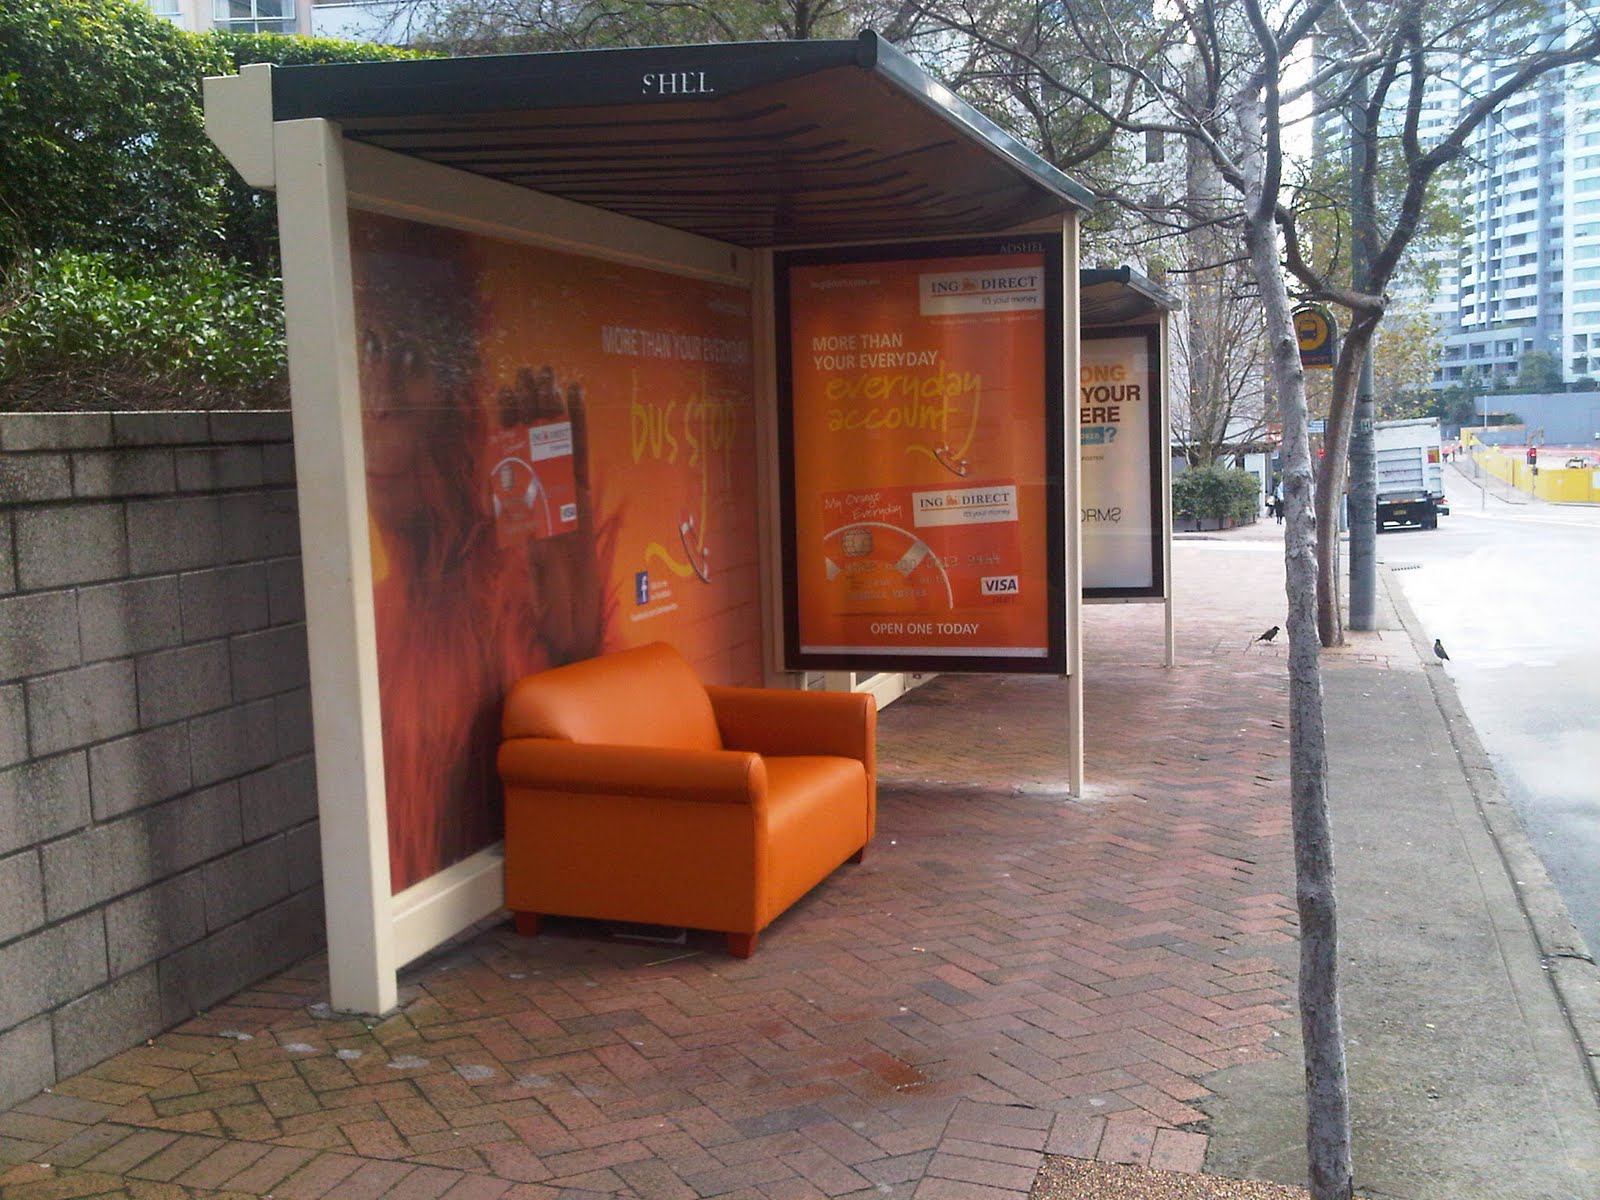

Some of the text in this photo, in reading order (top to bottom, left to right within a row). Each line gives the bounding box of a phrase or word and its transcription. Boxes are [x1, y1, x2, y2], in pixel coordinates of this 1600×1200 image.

[642, 72, 714, 94] SHEL
[931, 276, 1038, 293] ING DIRECT
[602, 325, 638, 356] MORE
[640, 330, 671, 359] THAN
[673, 335, 702, 361] YOUR
[812, 333, 903, 351] MORE THAN
[813, 351, 938, 371] YOUR EVERYDAY
[826, 360, 982, 436] everyday
[1081, 384, 1141, 403] YOUR
[829, 404, 959, 433] account
[1081, 406, 1120, 424] ERE
[919, 492, 1010, 508] ING DIRECT
[986, 579, 1017, 591] VISA
[870, 623, 980, 635] OPEN ONE TODAY
